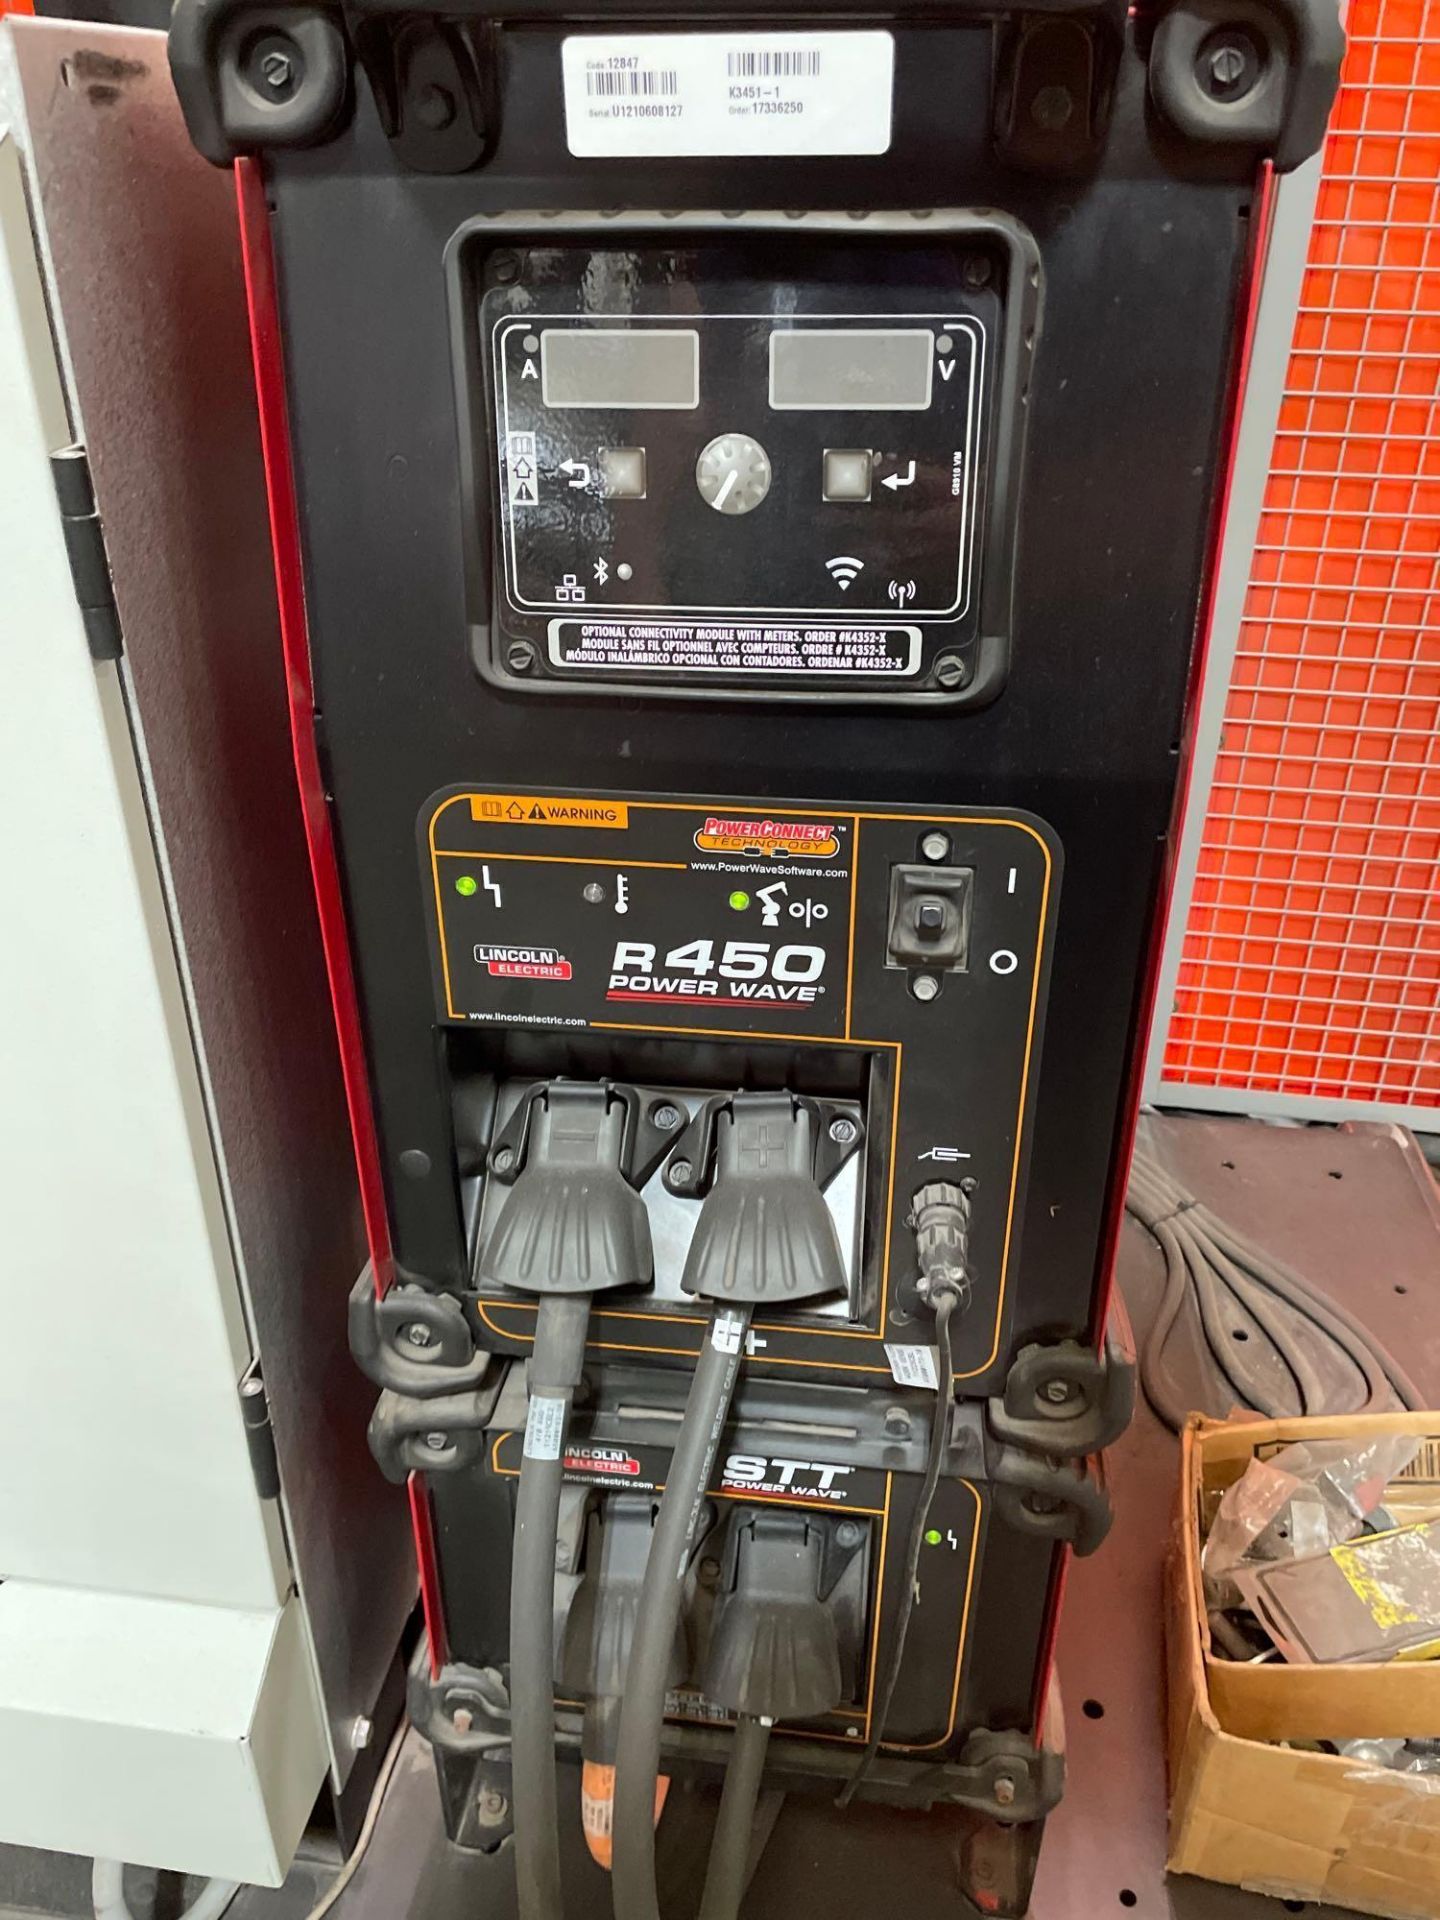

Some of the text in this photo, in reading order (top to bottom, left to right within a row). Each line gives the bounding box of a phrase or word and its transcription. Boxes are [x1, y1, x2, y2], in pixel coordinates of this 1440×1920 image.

[607, 57, 639, 70] 12847
[611, 103, 683, 118] U1210608127
[752, 101, 804, 115] 17336250
[521, 359, 538, 379] A
[938, 359, 956, 381] V
[581, 625, 887, 644] OPTIONAL CONNECTIVITY MODULE WITH METERS. ORDER #K4352-X
[582, 638, 619, 650] MODULE
[621, 639, 645, 651] SANS
[648, 639, 660, 651] FIL
[662, 640, 713, 653] OPTIONNEL
[715, 641, 739, 653] AVEC
[741, 642, 800, 655] COMPTEURS.
[801, 643, 833, 656] ORDRE
[845, 644, 886, 656] K4352-X
[566, 648, 903, 669] MÓDULO INALÁMBRICO OPCIONAL CON CONTADORES. ORDENAR #K4352-X
[547, 806, 617, 822] WARNING
[711, 836, 824, 850] TECHNOLOGY
[690, 861, 848, 878] www.PowerWaveSoftware.com
[479, 947, 554, 964] LINCOLN
[498, 964, 563, 977] ELECTRIC
[608, 974, 719, 995] POWER
[469, 1012, 587, 1026] www.lincolnelectric.com
[564, 1446, 623, 1462] INCOLN
[571, 1458, 632, 1472] ELECTRIC
[721, 1479, 786, 1493] POWER
